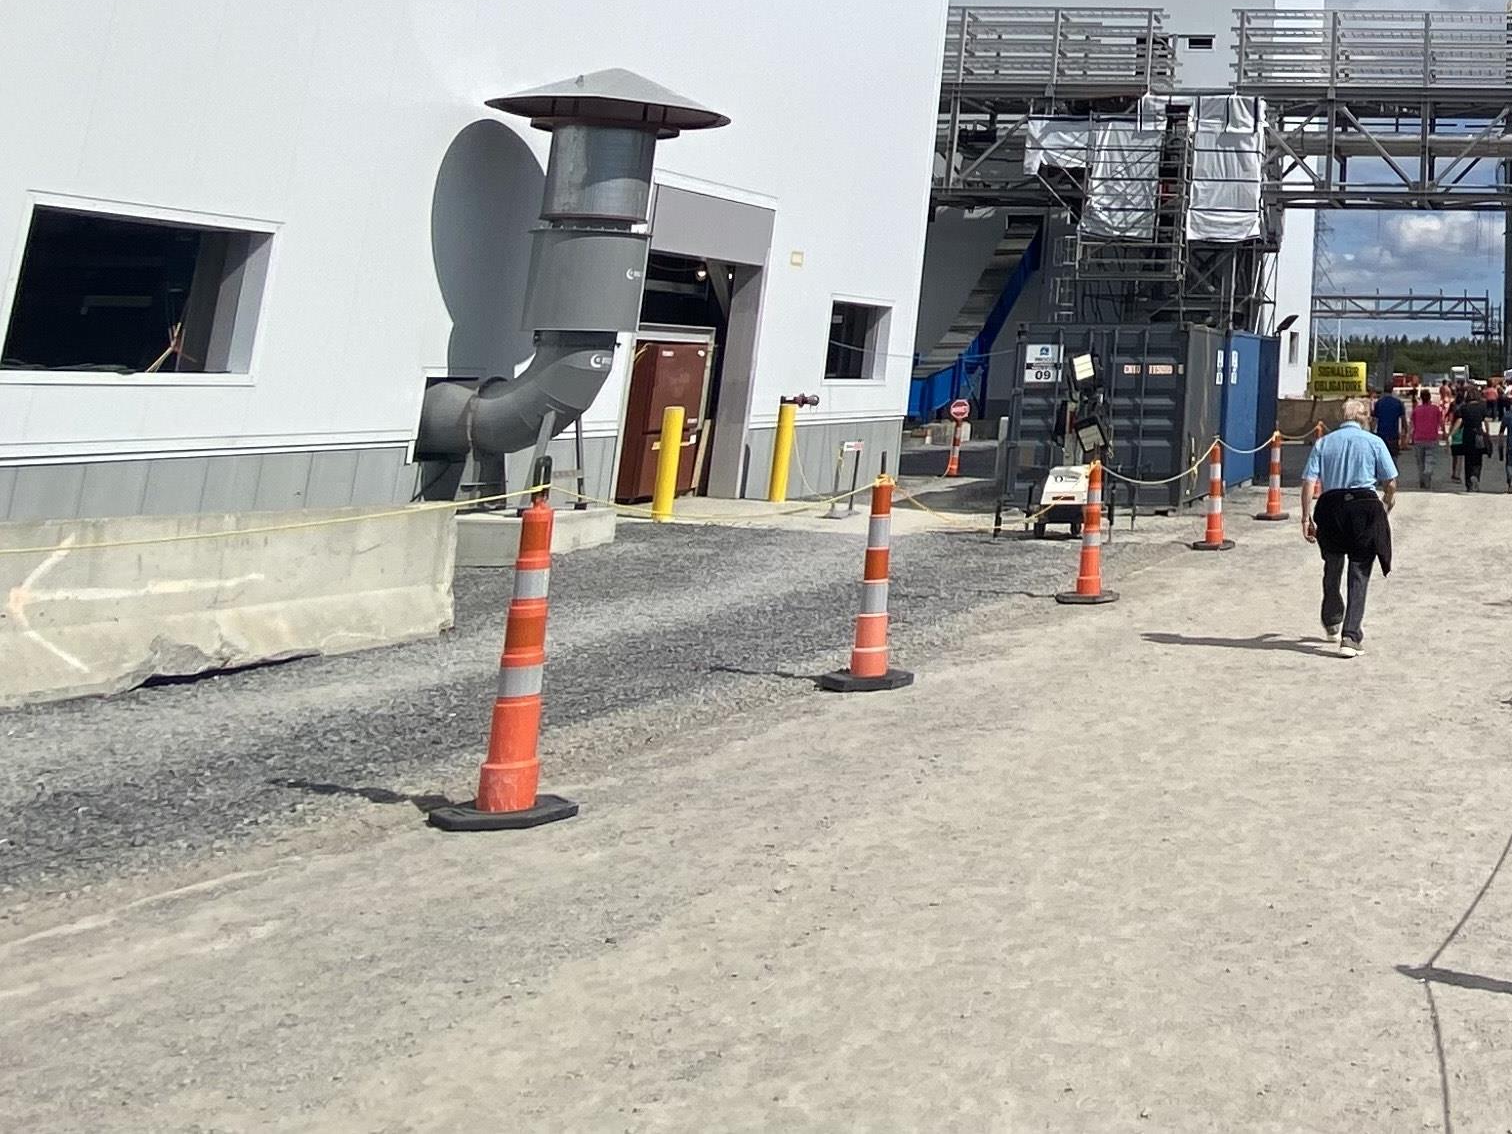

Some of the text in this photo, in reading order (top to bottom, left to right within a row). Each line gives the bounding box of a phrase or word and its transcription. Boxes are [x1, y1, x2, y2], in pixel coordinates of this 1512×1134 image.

[1034, 370, 1052, 380] 09
[1318, 366, 1360, 377] SIGNALEUR
[1314, 380, 1362, 392] OBLIGATOIRE
